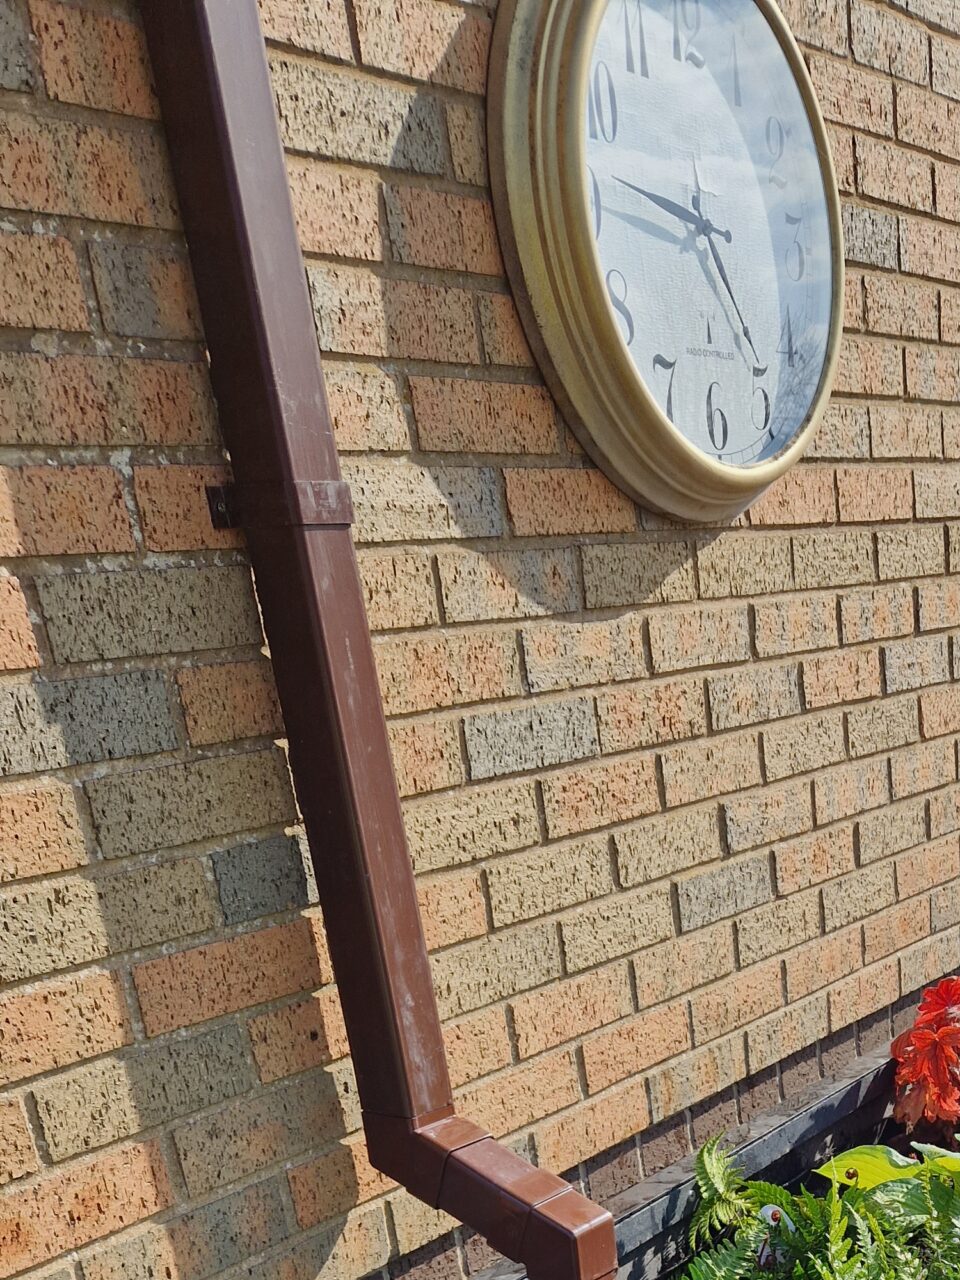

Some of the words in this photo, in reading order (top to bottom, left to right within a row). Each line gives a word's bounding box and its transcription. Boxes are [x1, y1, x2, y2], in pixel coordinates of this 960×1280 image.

[765, 116, 792, 189] 2
[785, 212, 805, 281] 3
[605, 269, 634, 346] 8
[776, 304, 799, 367] 4
[652, 354, 677, 424] 7
[706, 382, 728, 450] 6
[751, 363, 770, 430] 5
